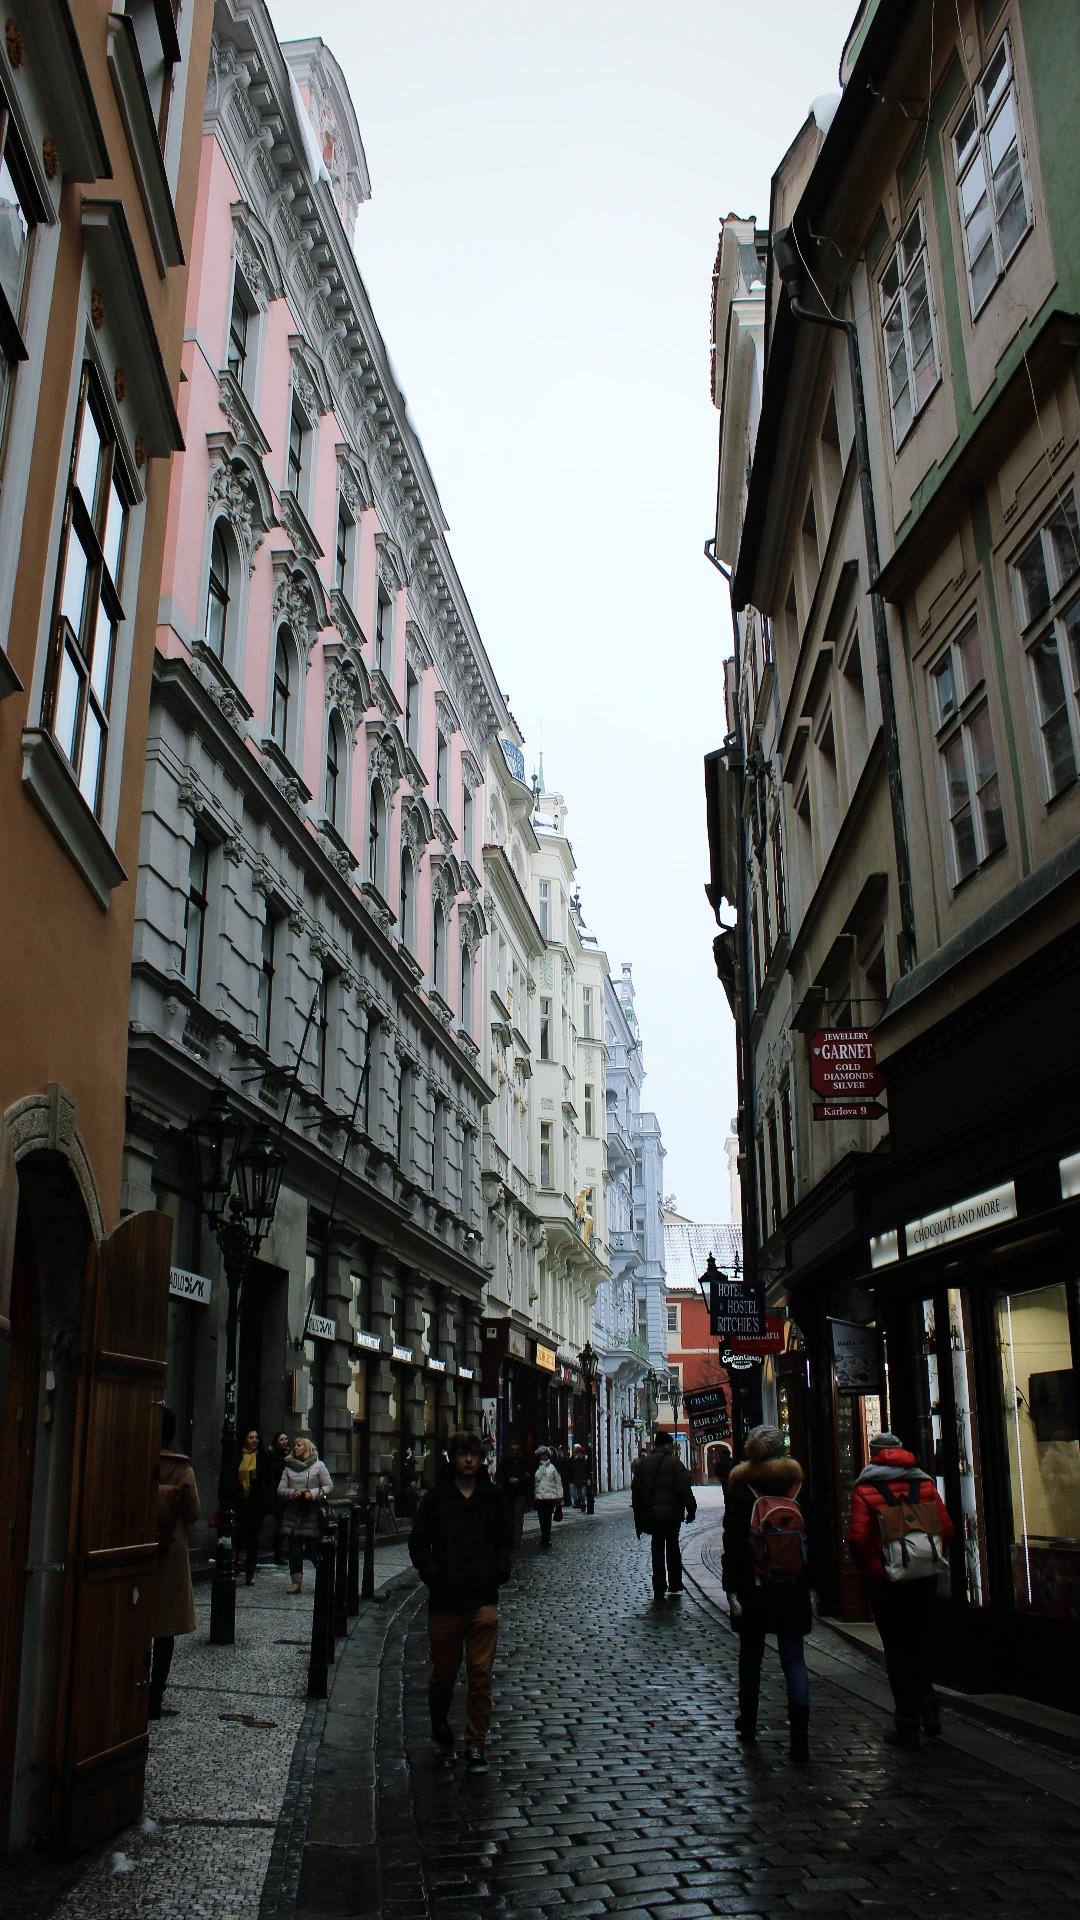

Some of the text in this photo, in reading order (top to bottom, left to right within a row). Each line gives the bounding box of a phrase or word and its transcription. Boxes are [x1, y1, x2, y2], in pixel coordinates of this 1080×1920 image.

[824, 1033, 869, 1041] JEWELLERY
[821, 1043, 873, 1060] GARNET
[835, 1063, 861, 1071] GOLD
[823, 1072, 874, 1081] DIAMONDS
[833, 1081, 866, 1090] SILVER
[823, 1106, 867, 1116] Karlova 9
[913, 1215, 957, 1244] CHOCOLATE
[957, 1208, 975, 1227] AND
[976, 1198, 1001, 1218] MORE
[718, 1283, 744, 1297] HOTEL
[727, 1300, 759, 1314] HOSTEL
[717, 1316, 760, 1333] RITCHIE'S
[693, 1417, 711, 1428] EUR
[695, 1434, 714, 1444] USD
